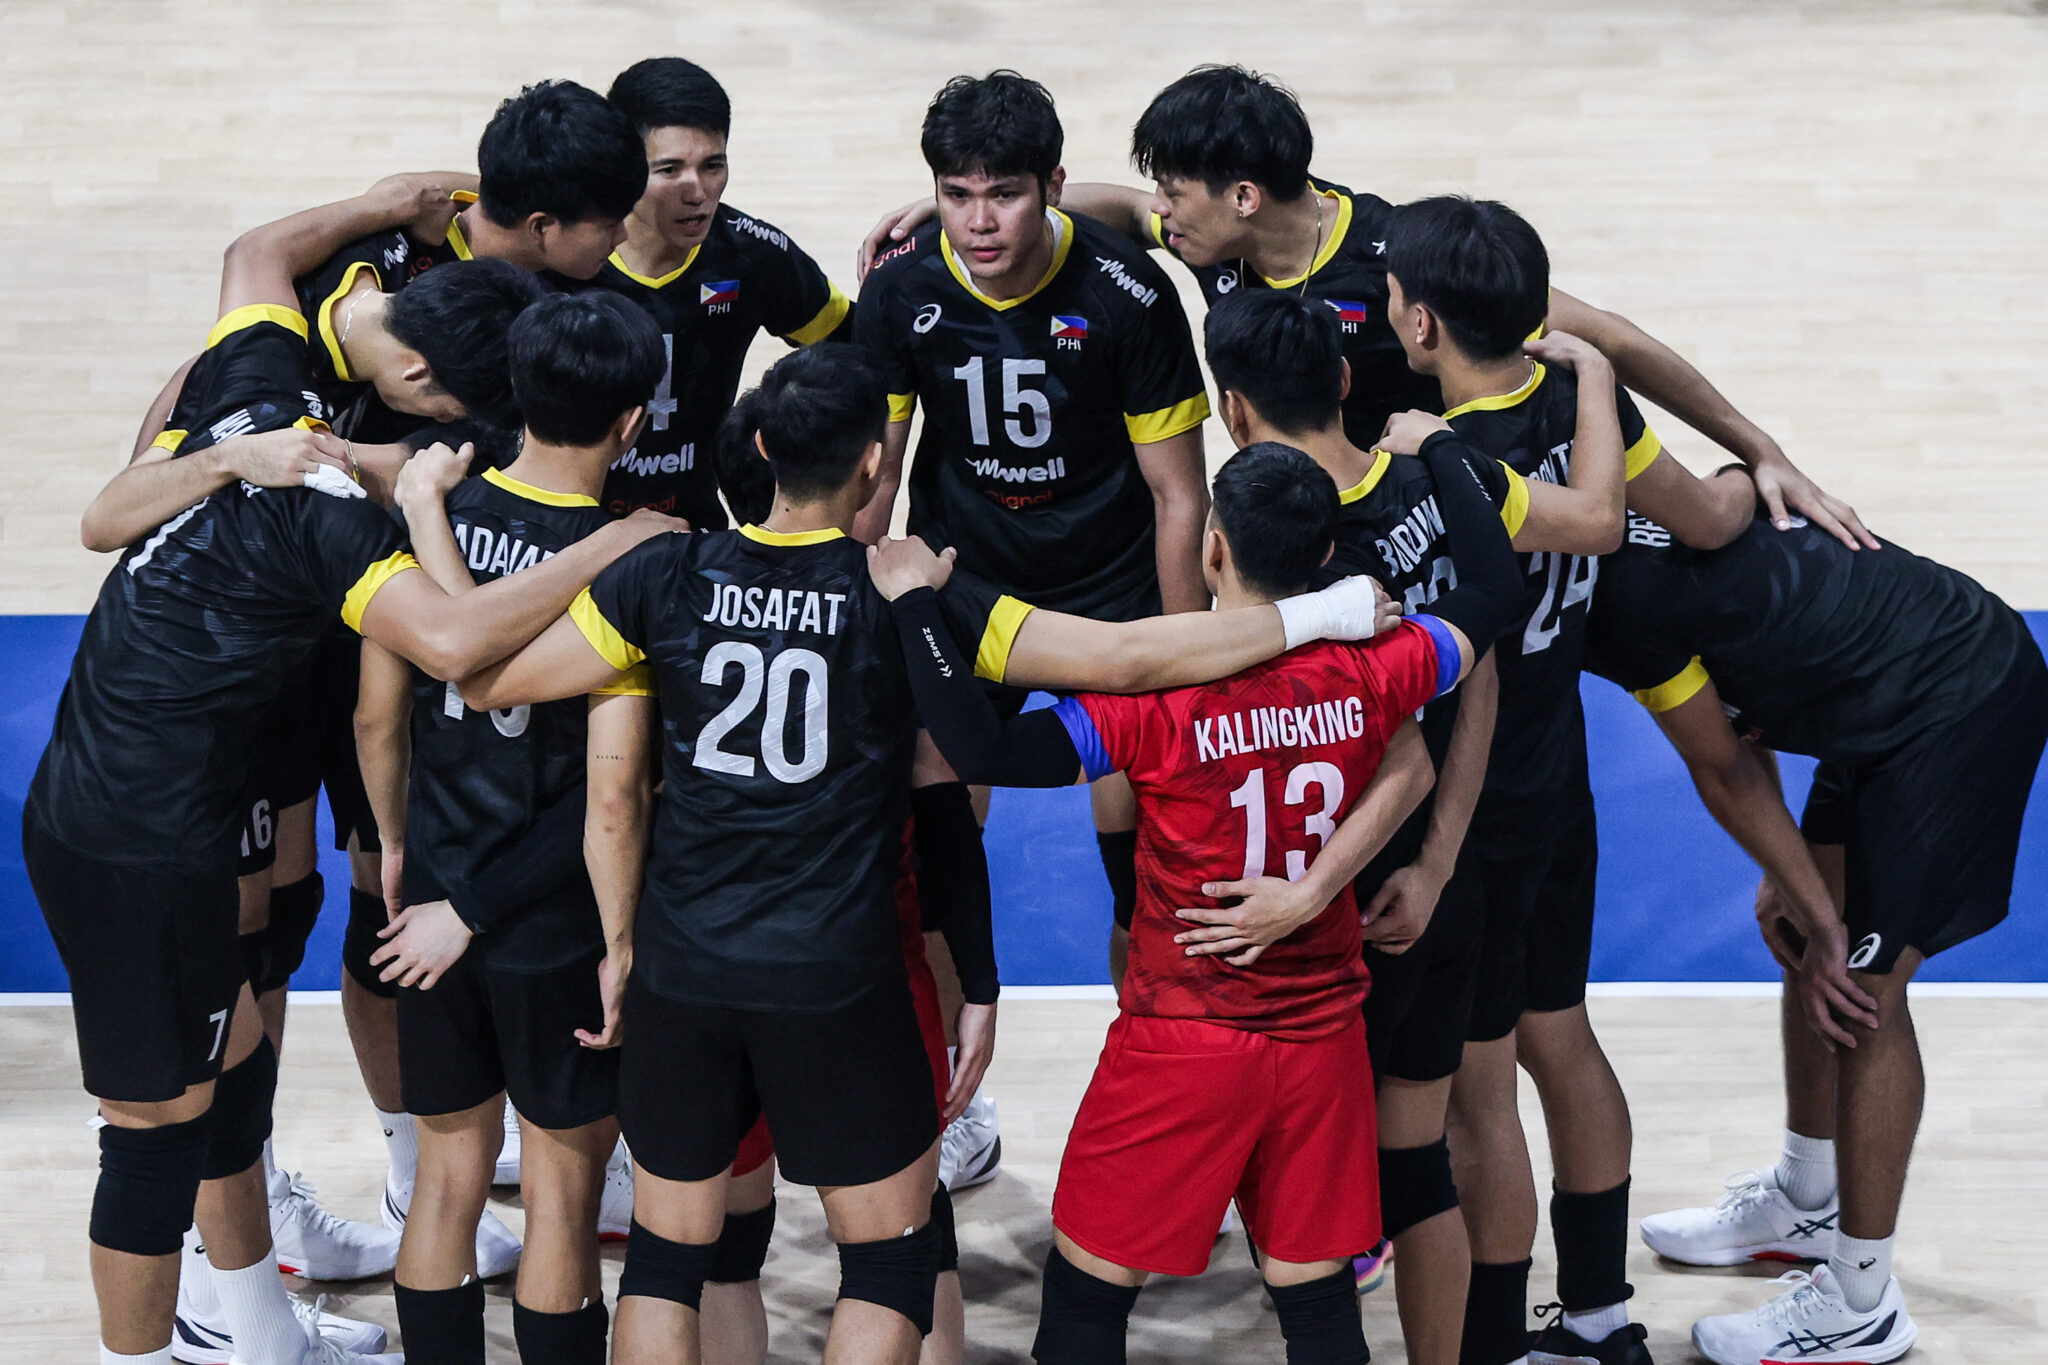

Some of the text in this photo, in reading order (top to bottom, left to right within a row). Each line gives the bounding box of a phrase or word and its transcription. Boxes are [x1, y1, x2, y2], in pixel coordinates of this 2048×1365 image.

[727, 217, 789, 253] Mwell
[870, 235, 917, 270] gnal
[1095, 256, 1159, 308] Mwell
[708, 301, 732, 317] PHI
[1340, 321, 1358, 334] HI
[1056, 337, 1082, 351] PHI
[953, 355, 1052, 449] 15
[609, 441, 696, 478] Mwell
[964, 456, 1066, 484] Mwell
[702, 582, 847, 636] JOSAFAT
[691, 640, 829, 784] 20
[1193, 695, 1365, 763] KALINGKING
[1229, 761, 1345, 883] 13
[207, 1008, 228, 1061] 7
